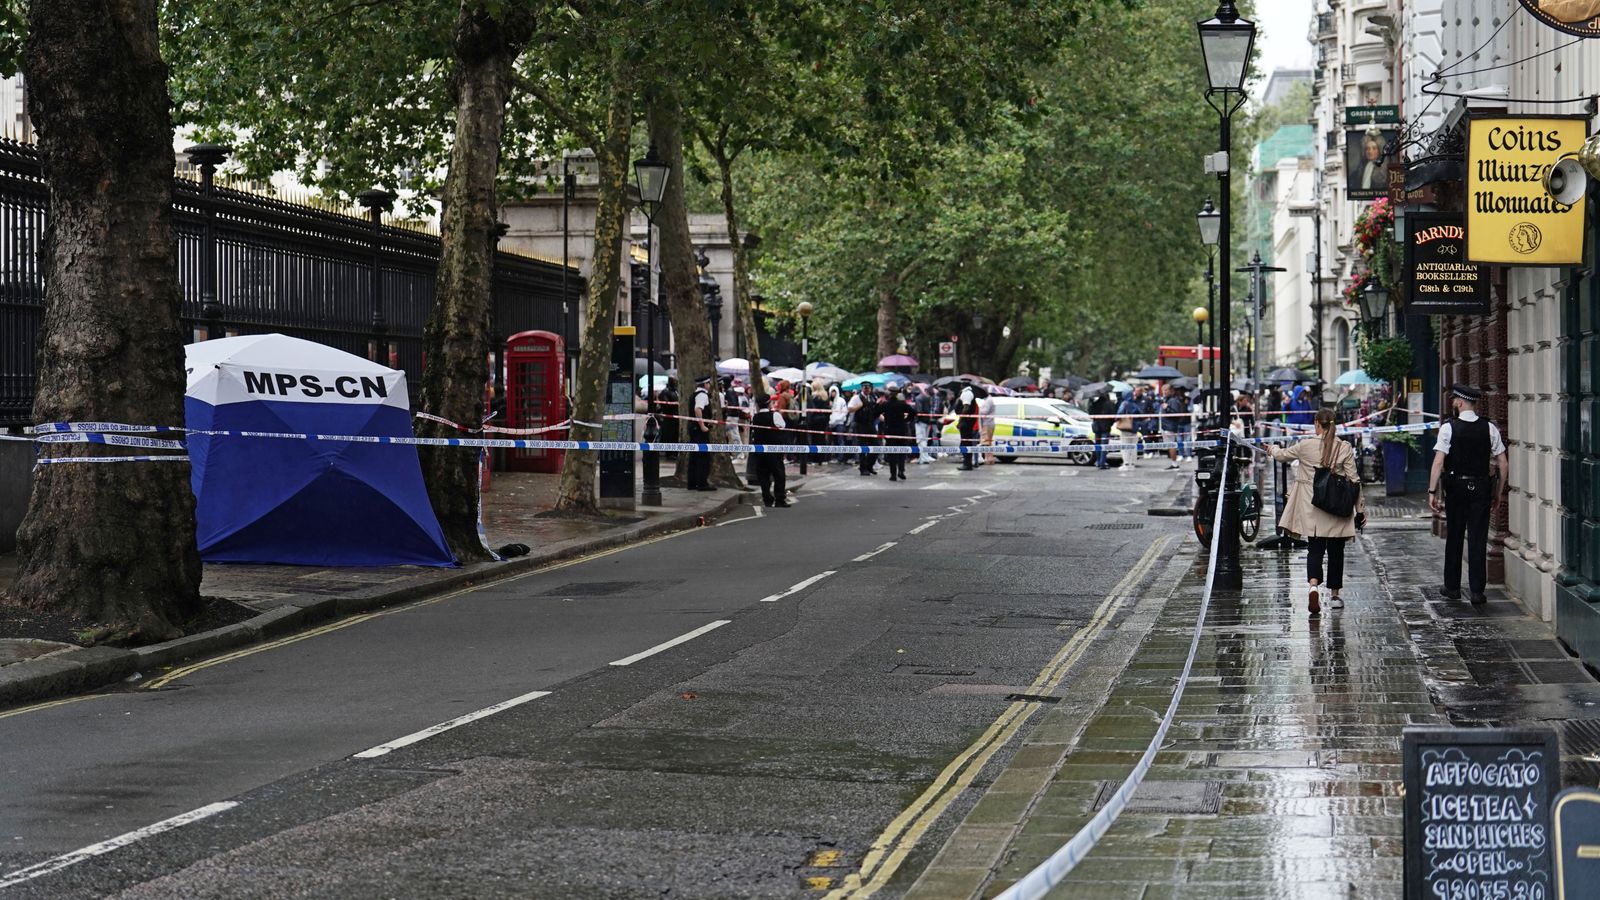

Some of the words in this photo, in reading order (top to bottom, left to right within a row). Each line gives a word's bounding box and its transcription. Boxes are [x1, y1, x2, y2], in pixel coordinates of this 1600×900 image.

[1488, 126, 1562, 151] Coins
[1477, 159, 1552, 182] Münz
[1415, 226, 1464, 244] JARNDY
[1416, 263, 1478, 271] ANTIQUARIAN
[1416, 272, 1478, 280] BOOKSELLERS
[1420, 284, 1440, 292] C18th
[1442, 284, 1450, 292] &
[1453, 284, 1474, 292] C19th
[244, 371, 388, 398] MPS-CN
[112, 436, 129, 444] CROSS
[130, 438, 141, 446] NOT
[142, 438, 150, 446] DO
[1426, 762, 1540, 787] AFFOGATO
[1424, 824, 1546, 849] SANDWICHES
